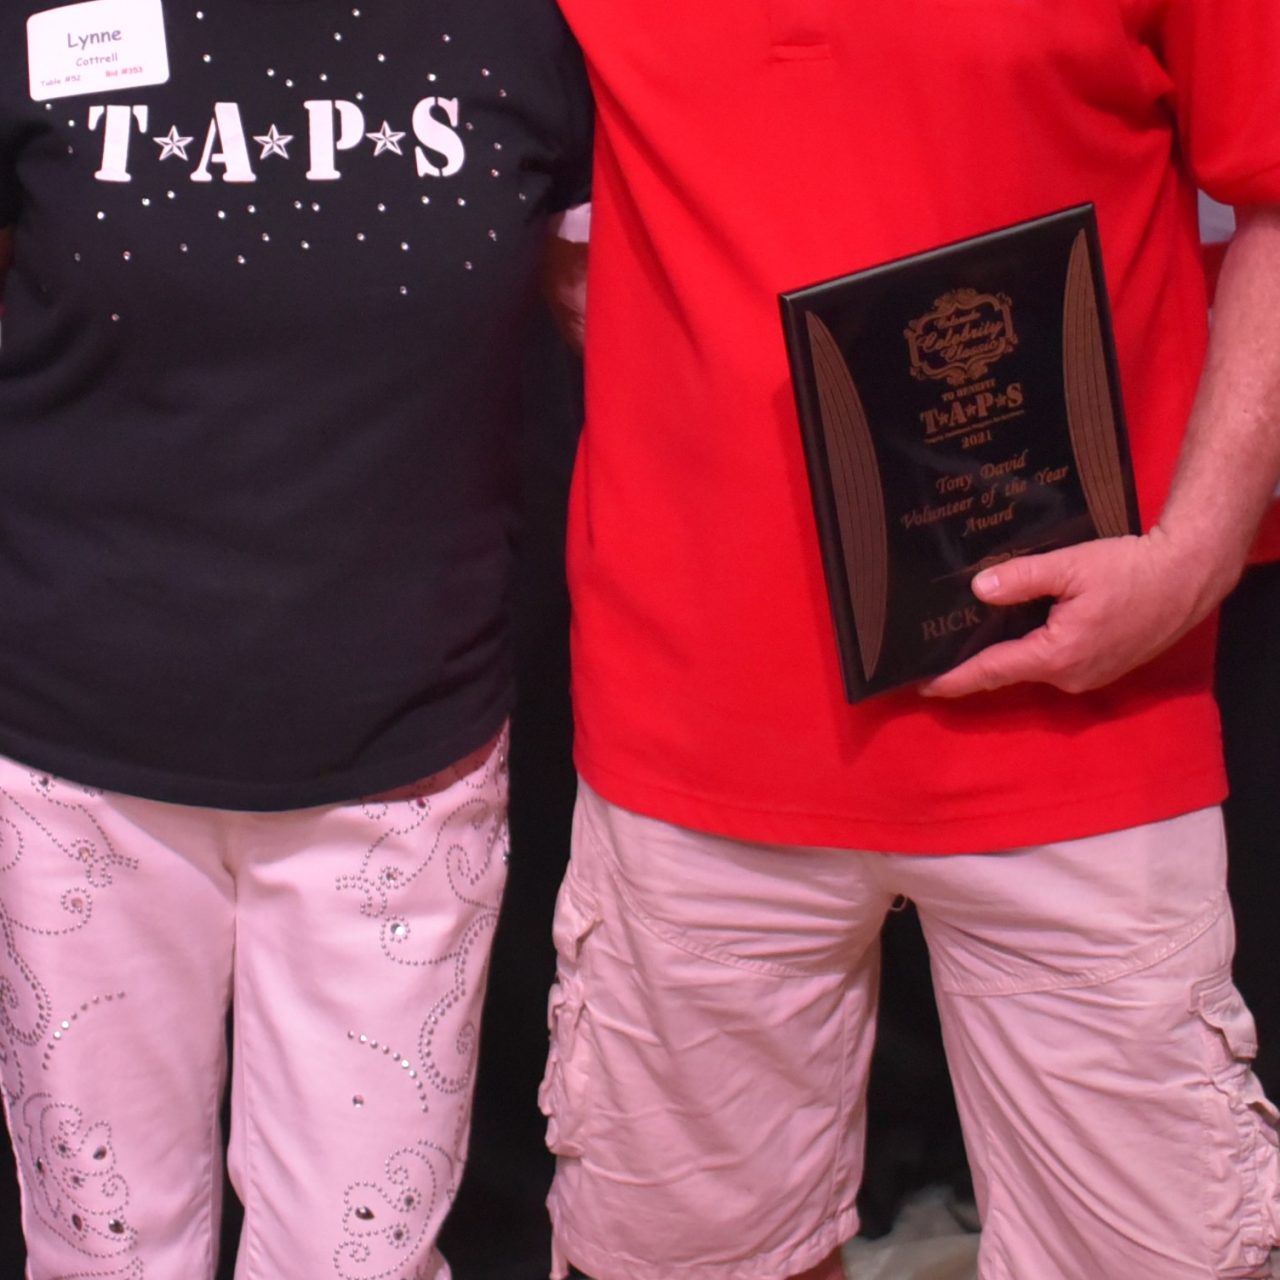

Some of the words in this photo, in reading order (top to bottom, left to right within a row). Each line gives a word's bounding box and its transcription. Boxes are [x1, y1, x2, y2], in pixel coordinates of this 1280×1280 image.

[67, 29, 122, 51] Lynne
[75, 52, 118, 67] Cottrell
[961, 430, 992, 448] 2021
[935, 472, 973, 494] Tony
[979, 448, 1029, 479] David
[900, 497, 975, 529] Volunteer
[981, 484, 998, 508] of
[1035, 466, 1069, 486] Year
[963, 502, 1016, 537] Award
[922, 606, 982, 640] RICK
